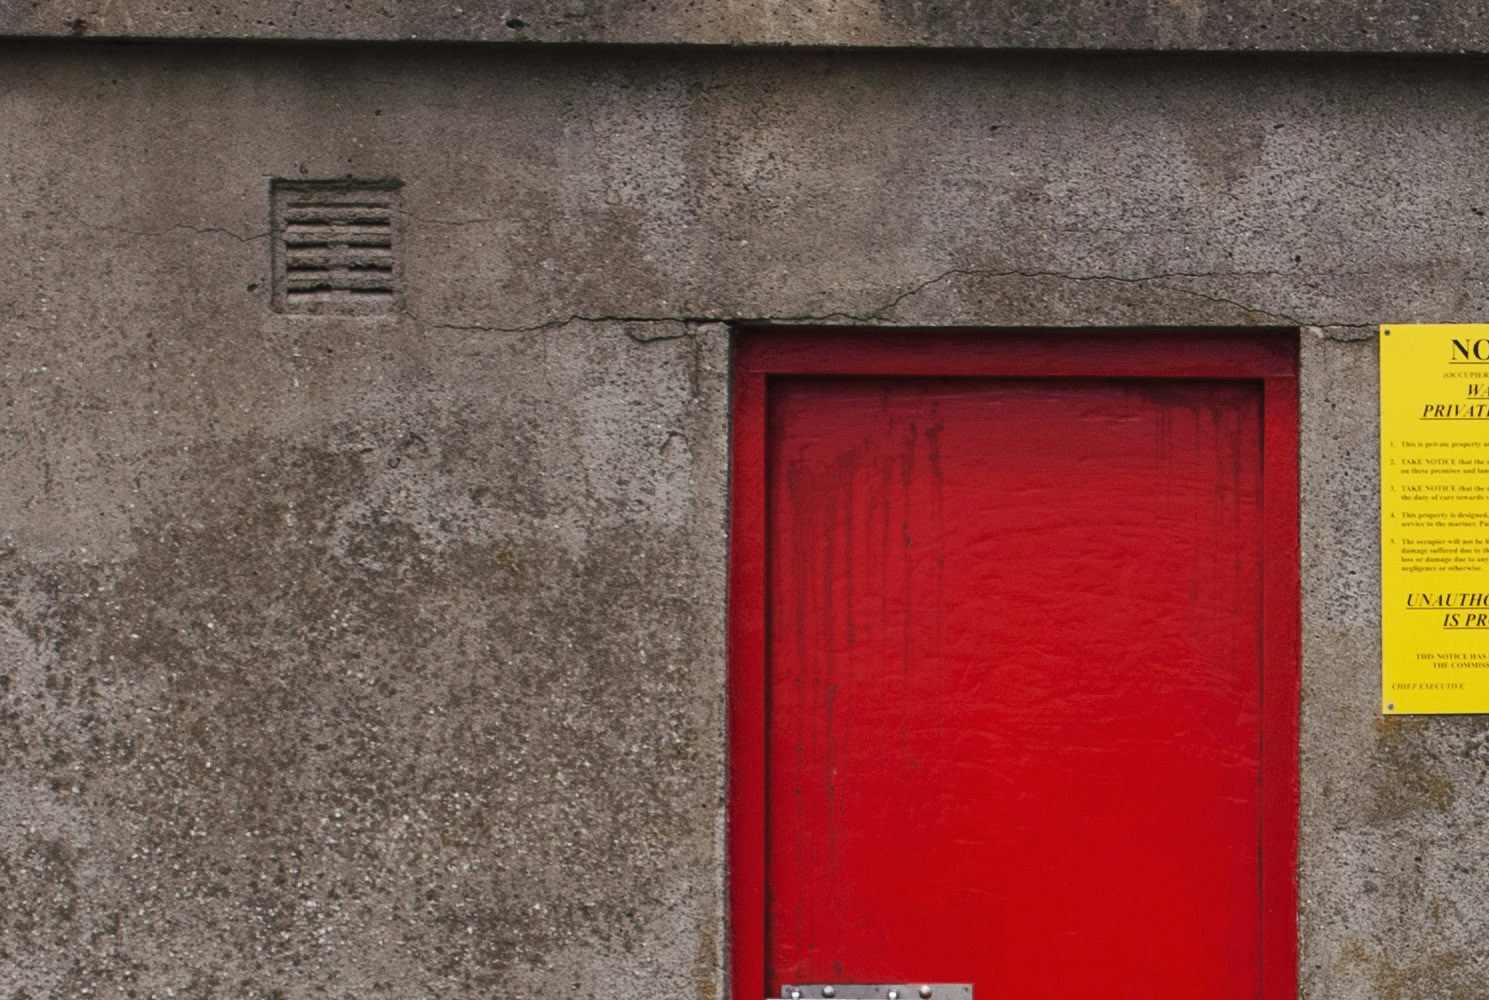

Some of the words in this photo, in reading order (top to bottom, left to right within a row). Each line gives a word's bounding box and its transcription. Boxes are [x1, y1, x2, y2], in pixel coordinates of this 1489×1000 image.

[1402, 440, 1416, 448] This
[1425, 441, 1449, 449] private
[1451, 441, 1481, 449] property
[1411, 467, 1428, 475] these
[1430, 468, 1461, 476] premises
[1462, 467, 1476, 475] and
[1425, 484, 1456, 492] NOTICE
[1413, 493, 1428, 502] duty
[1402, 511, 1416, 519] This
[1418, 513, 1448, 521] property
[1457, 512, 1489, 520] designed,
[1435, 520, 1446, 528] the
[1416, 539, 1446, 547] occupier
[1401, 548, 1428, 556] damage
[1430, 546, 1458, 554] suffered
[1425, 556, 1452, 564] damage
[1453, 555, 1466, 563] due
[1443, 614, 1460, 626] IS
[1433, 661, 1449, 669] THE
